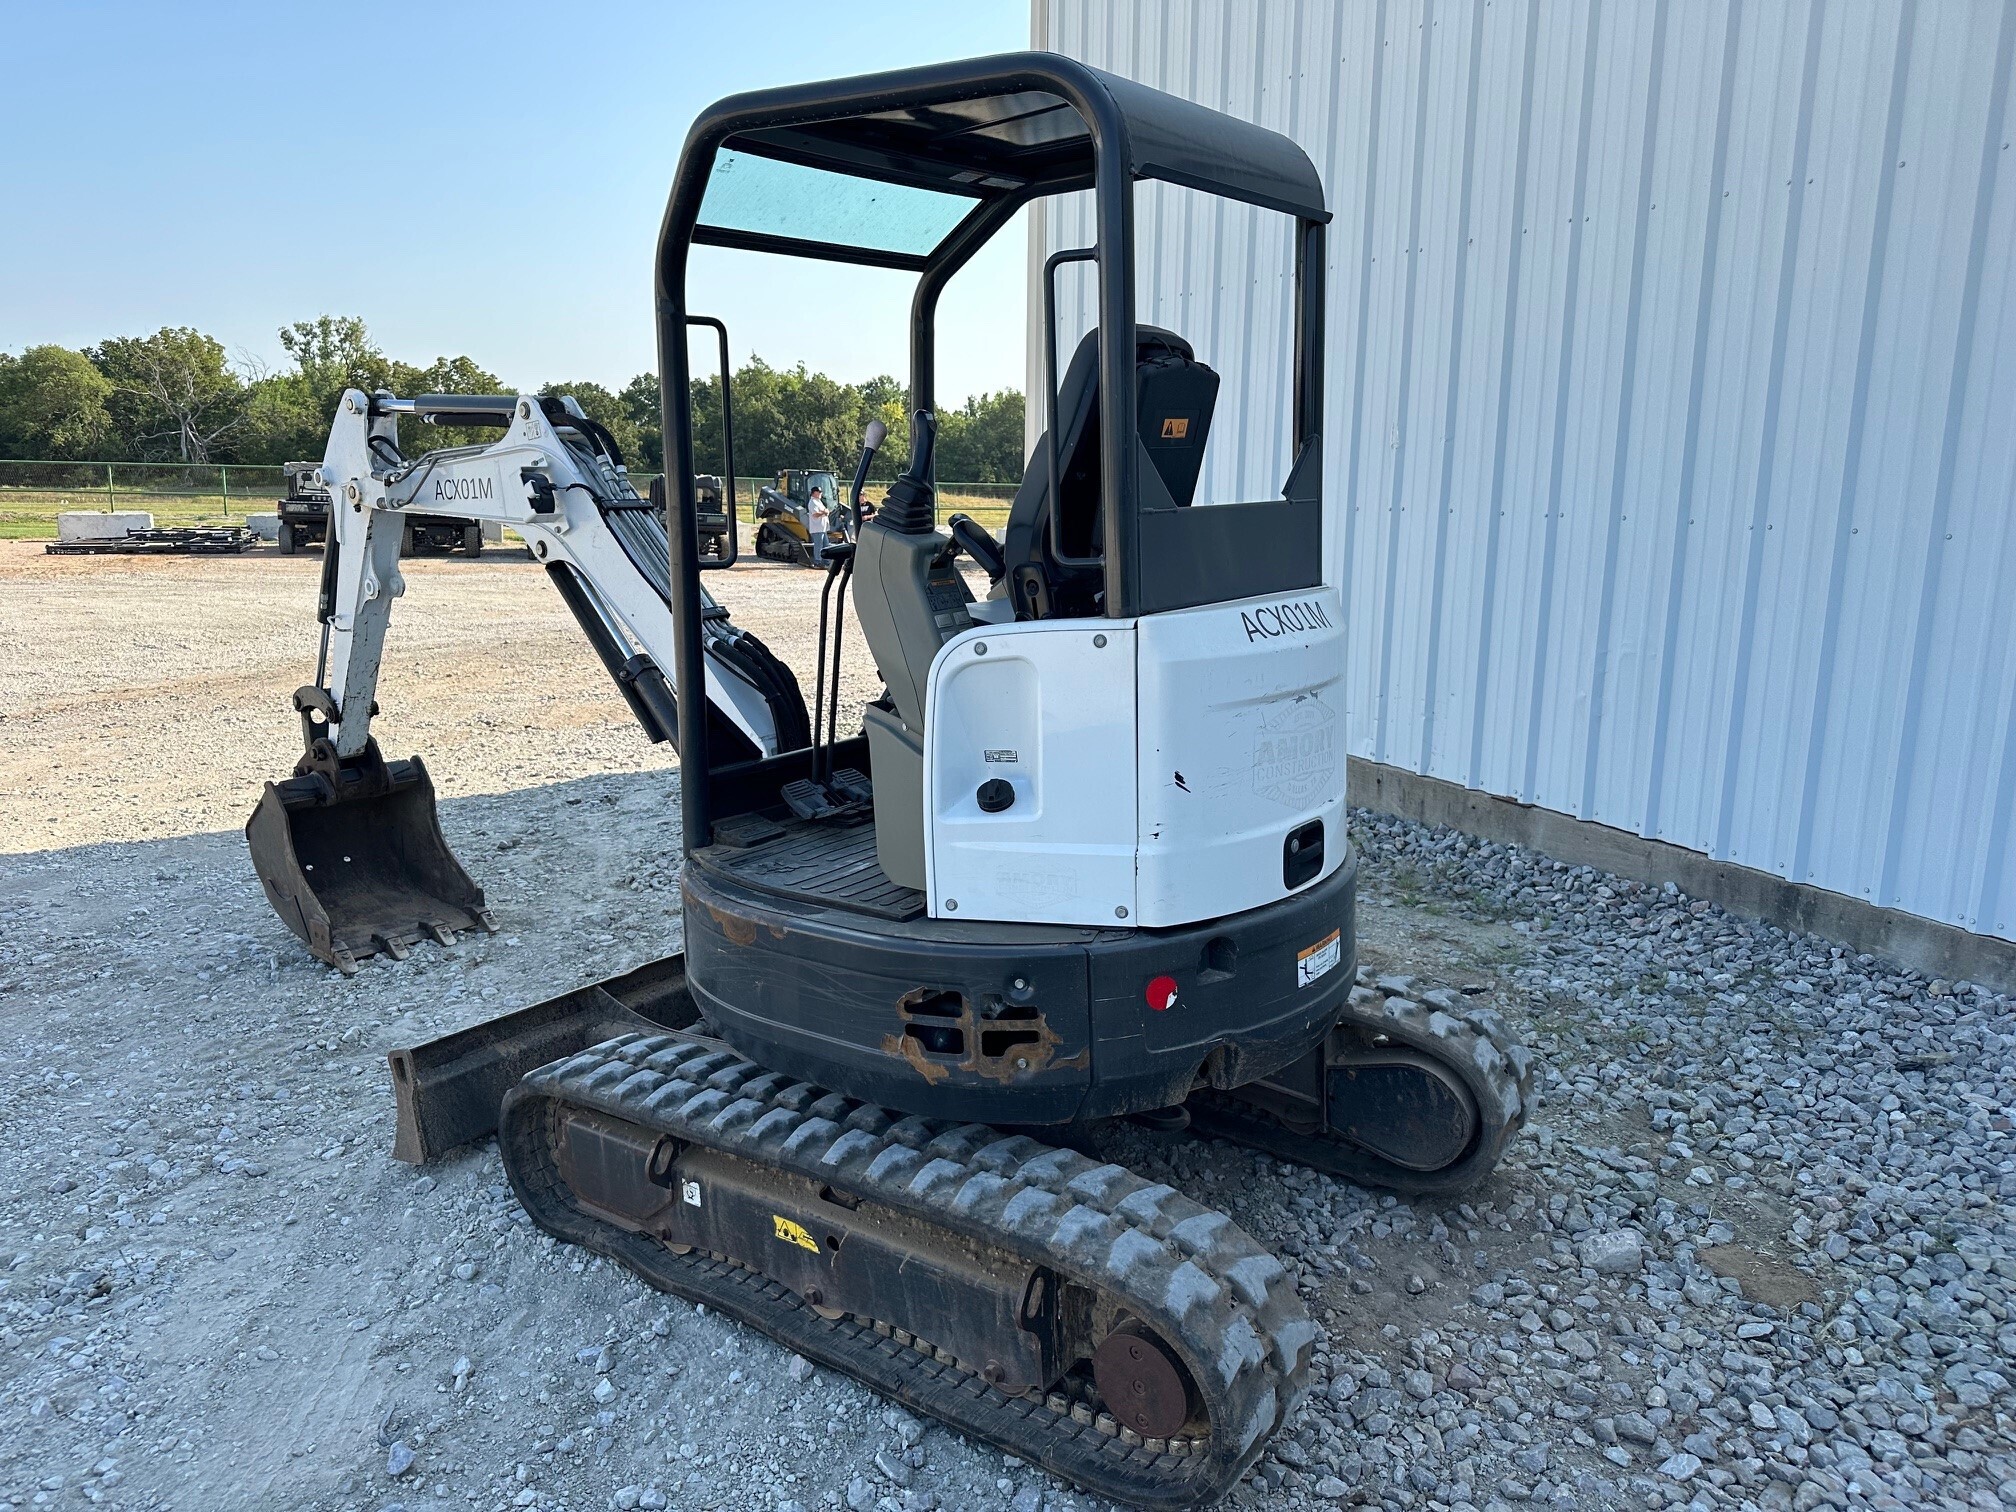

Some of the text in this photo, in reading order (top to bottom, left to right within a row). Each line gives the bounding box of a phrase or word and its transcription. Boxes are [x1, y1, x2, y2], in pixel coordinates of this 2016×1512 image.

[435, 477, 493, 500] ACX01M
[1241, 601, 1333, 642] ACX01M
[1257, 750, 1334, 780] CONSTRUCTION
